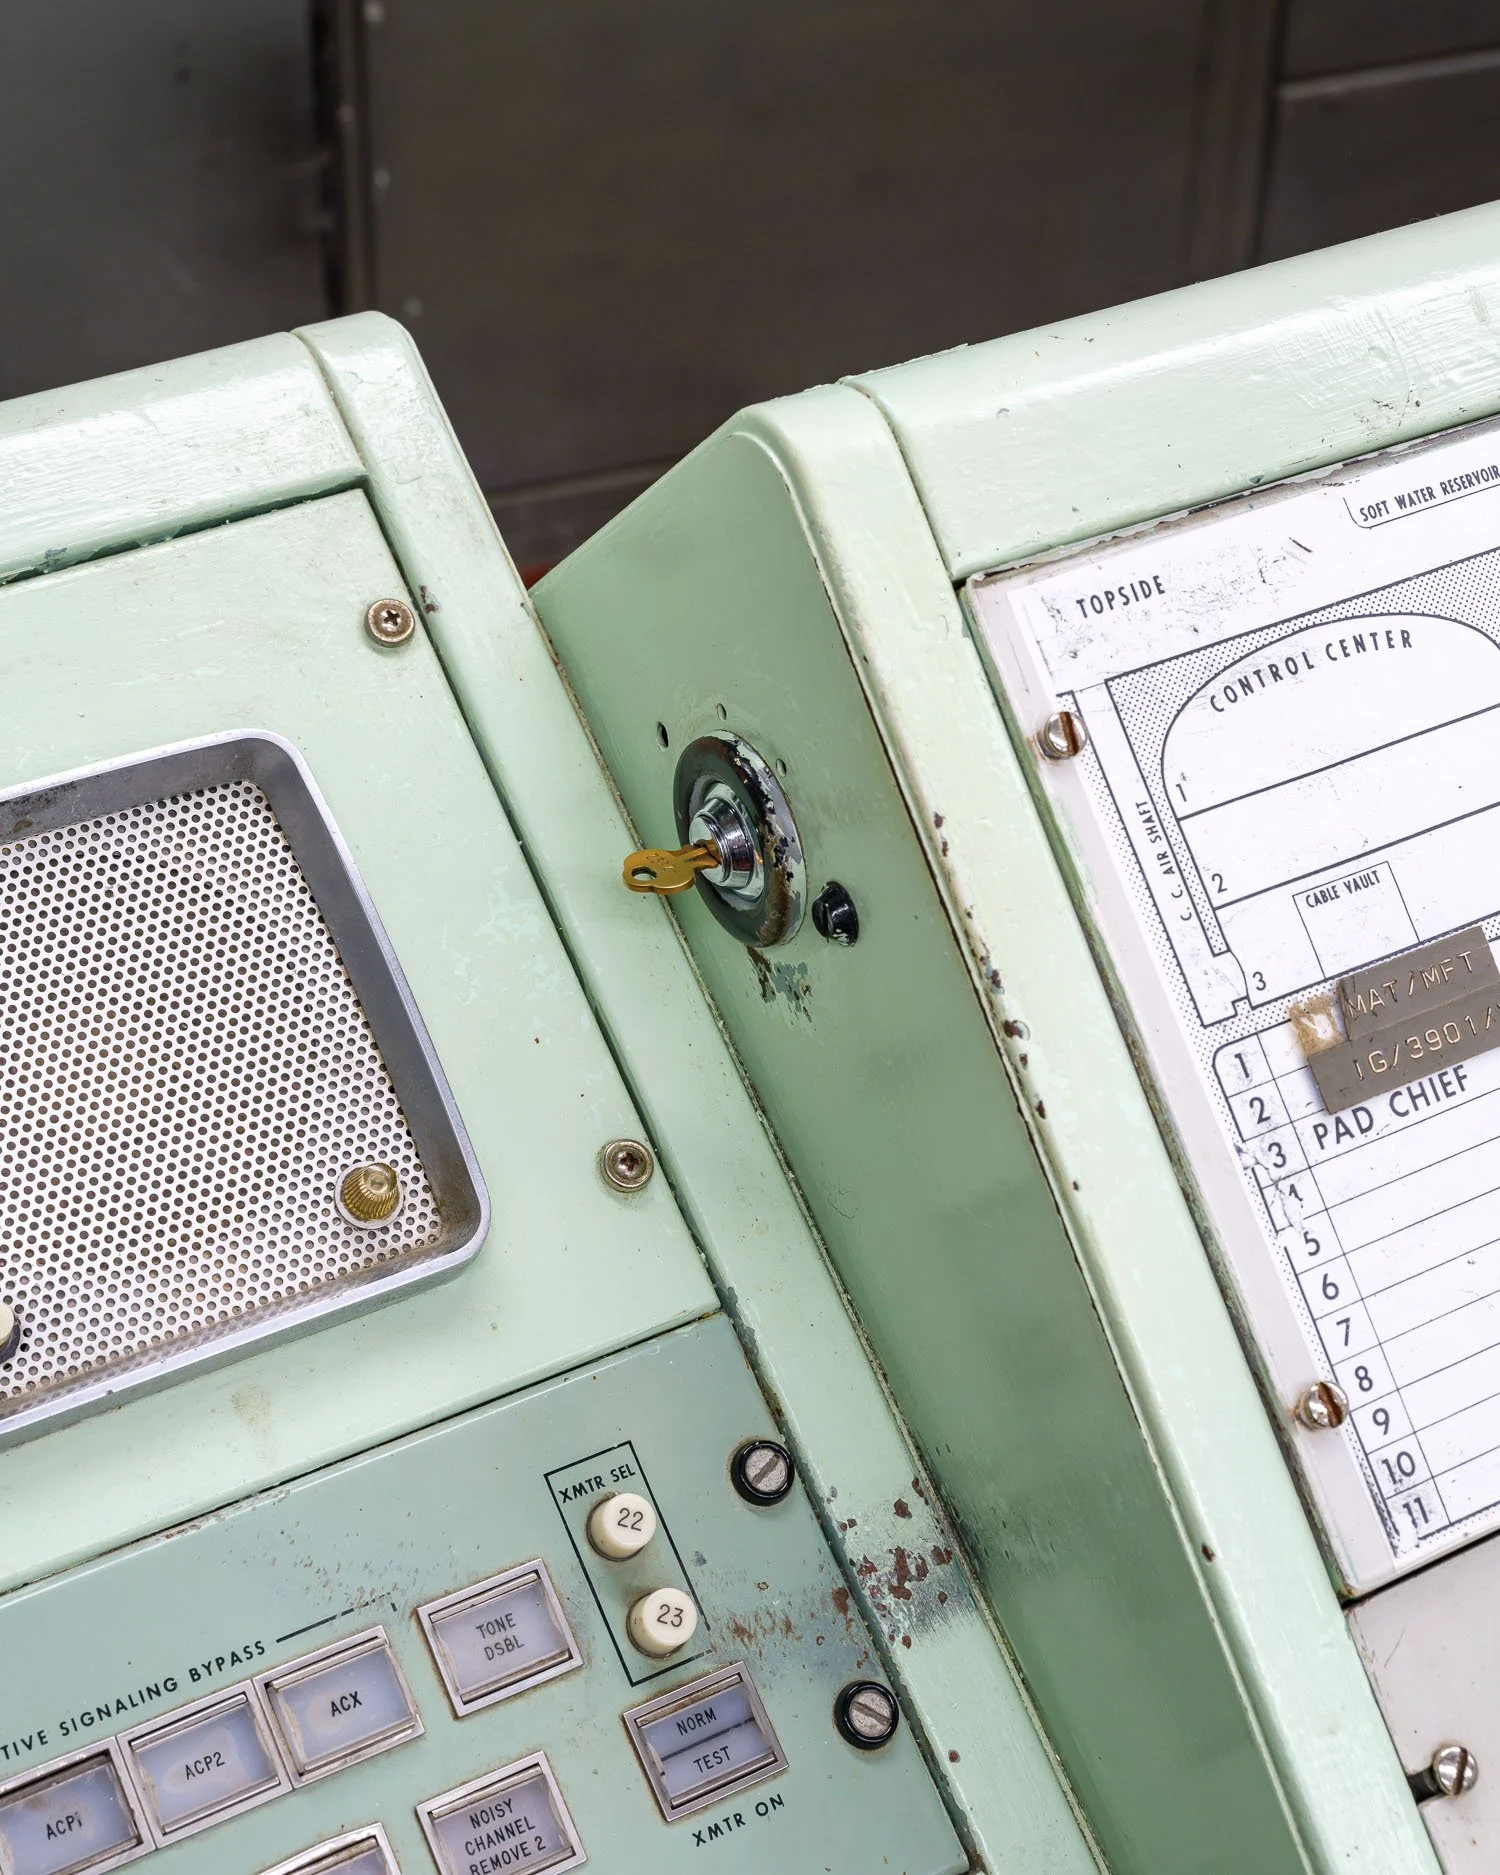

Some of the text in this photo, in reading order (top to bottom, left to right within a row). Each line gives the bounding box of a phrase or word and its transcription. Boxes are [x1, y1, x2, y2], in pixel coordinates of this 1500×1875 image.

[1359, 464, 1500, 522] SOFT WATER RESERVOIR
[1076, 575, 1165, 618] TOPSIDE
[1210, 629, 1413, 712] CONTROL CENTER
[1135, 801, 1162, 844] SHAFT
[1156, 851, 1175, 875] AIR
[1211, 874, 1228, 893] 2
[1306, 870, 1381, 908] CABLE VAULT
[1252, 971, 1267, 991] 3
[1348, 950, 1473, 1018] MAT/MFT
[1234, 1052, 1250, 1079] 1
[1249, 1096, 1271, 1124] 2
[1312, 1063, 1468, 1150] PAD CHIEF
[1267, 1141, 1287, 1169] 3
[1303, 1230, 1321, 1257] 5
[1321, 1273, 1339, 1301] 6
[1336, 1317, 1351, 1346] 7
[1354, 1365, 1373, 1392] 8
[1372, 1407, 1390, 1435] 9
[1381, 1451, 1416, 1485] 10
[558, 1463, 636, 1504] XMTR SEL
[616, 1507, 644, 1531] 22
[1402, 1497, 1429, 1528] 11
[476, 1612, 517, 1640] TONE
[656, 1603, 684, 1628] 23
[485, 1636, 525, 1662] DSBL
[0, 1640, 266, 1760] TIVE SIGNALING BYPASS
[330, 1691, 363, 1717] ACX
[676, 1707, 717, 1736] NORM
[184, 1751, 226, 1780] ACP2
[694, 1746, 731, 1774] TEST
[469, 1798, 513, 1829] NOISY
[692, 1793, 785, 1847] XMTR ON
[465, 1816, 536, 1856] CHANNEL
[469, 1836, 547, 1875] REMOVE 2
